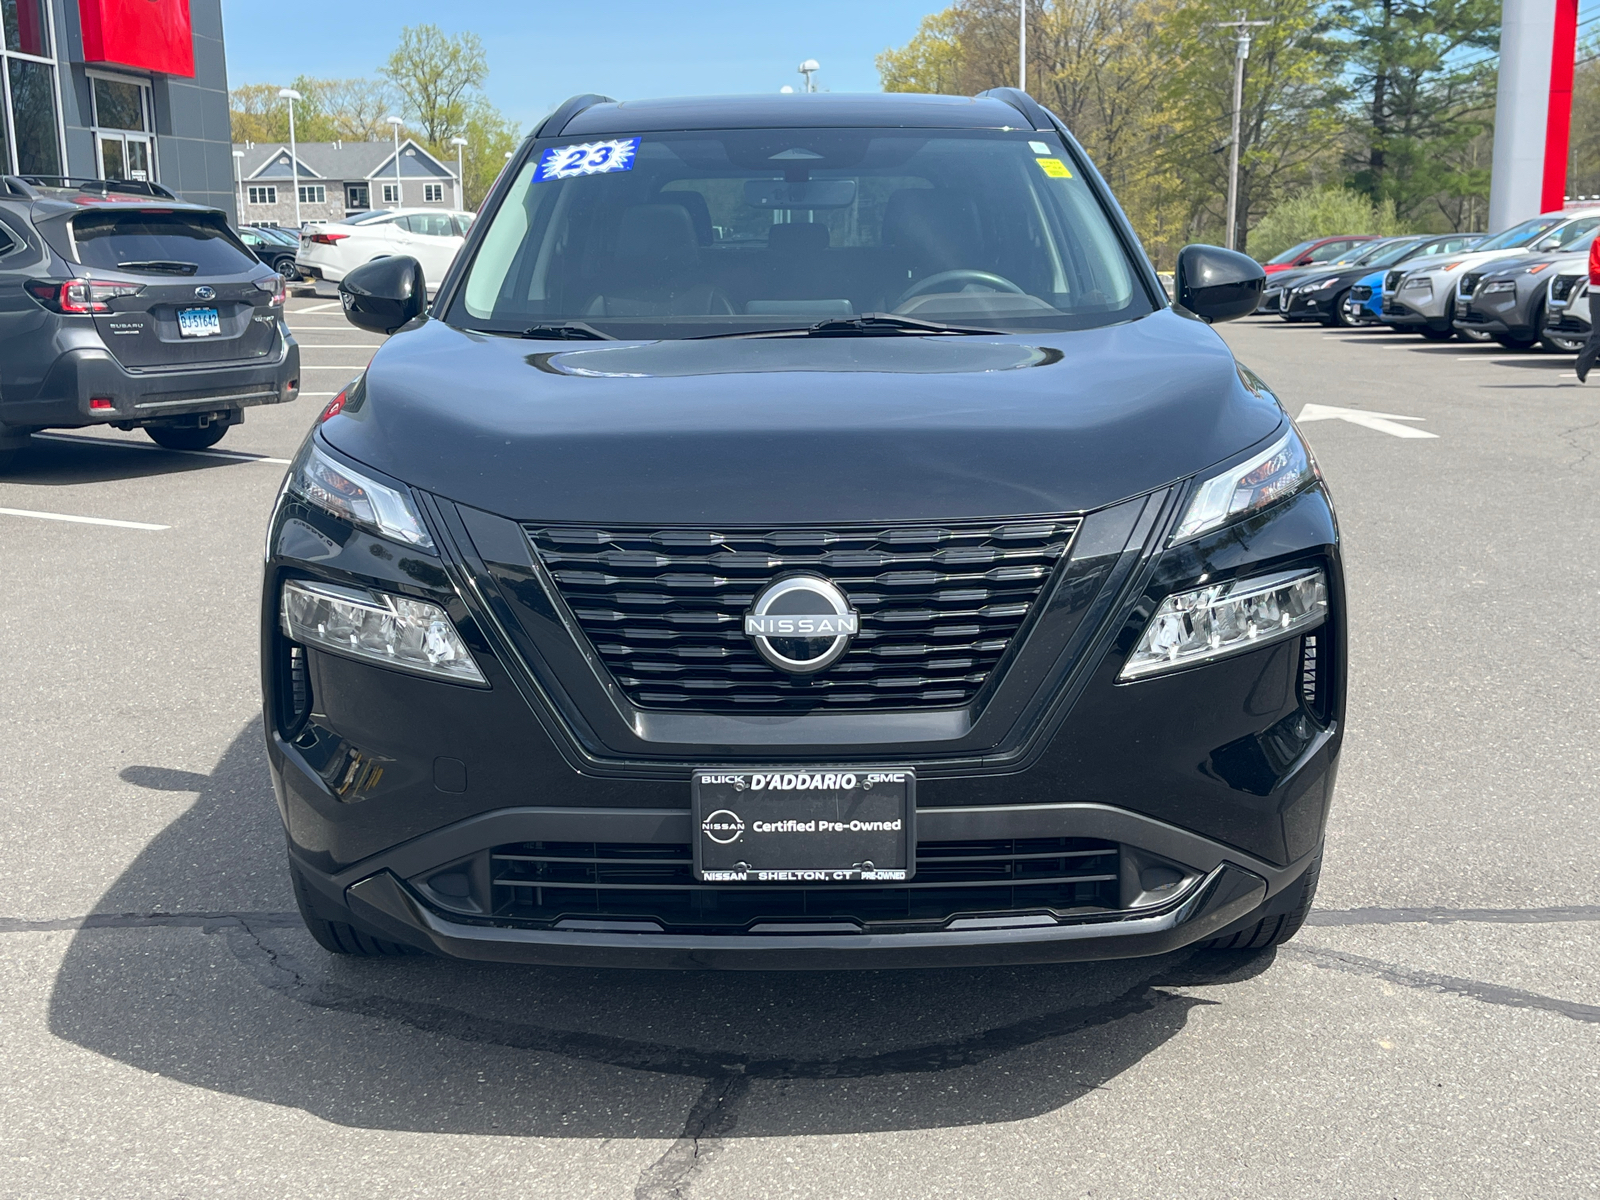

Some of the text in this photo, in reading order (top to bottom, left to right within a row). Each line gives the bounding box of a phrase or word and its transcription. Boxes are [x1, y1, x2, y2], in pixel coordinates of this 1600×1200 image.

[560, 146, 613, 171] 23
[748, 618, 854, 633] NISSAN
[701, 773, 905, 790] BUICK D'ADDARIO GMC
[702, 823, 745, 831] NISSAN
[753, 818, 902, 832] Certified Pre-Owned
[703, 871, 905, 881] NISSAN SHELTON, CT PRE-OWNED
